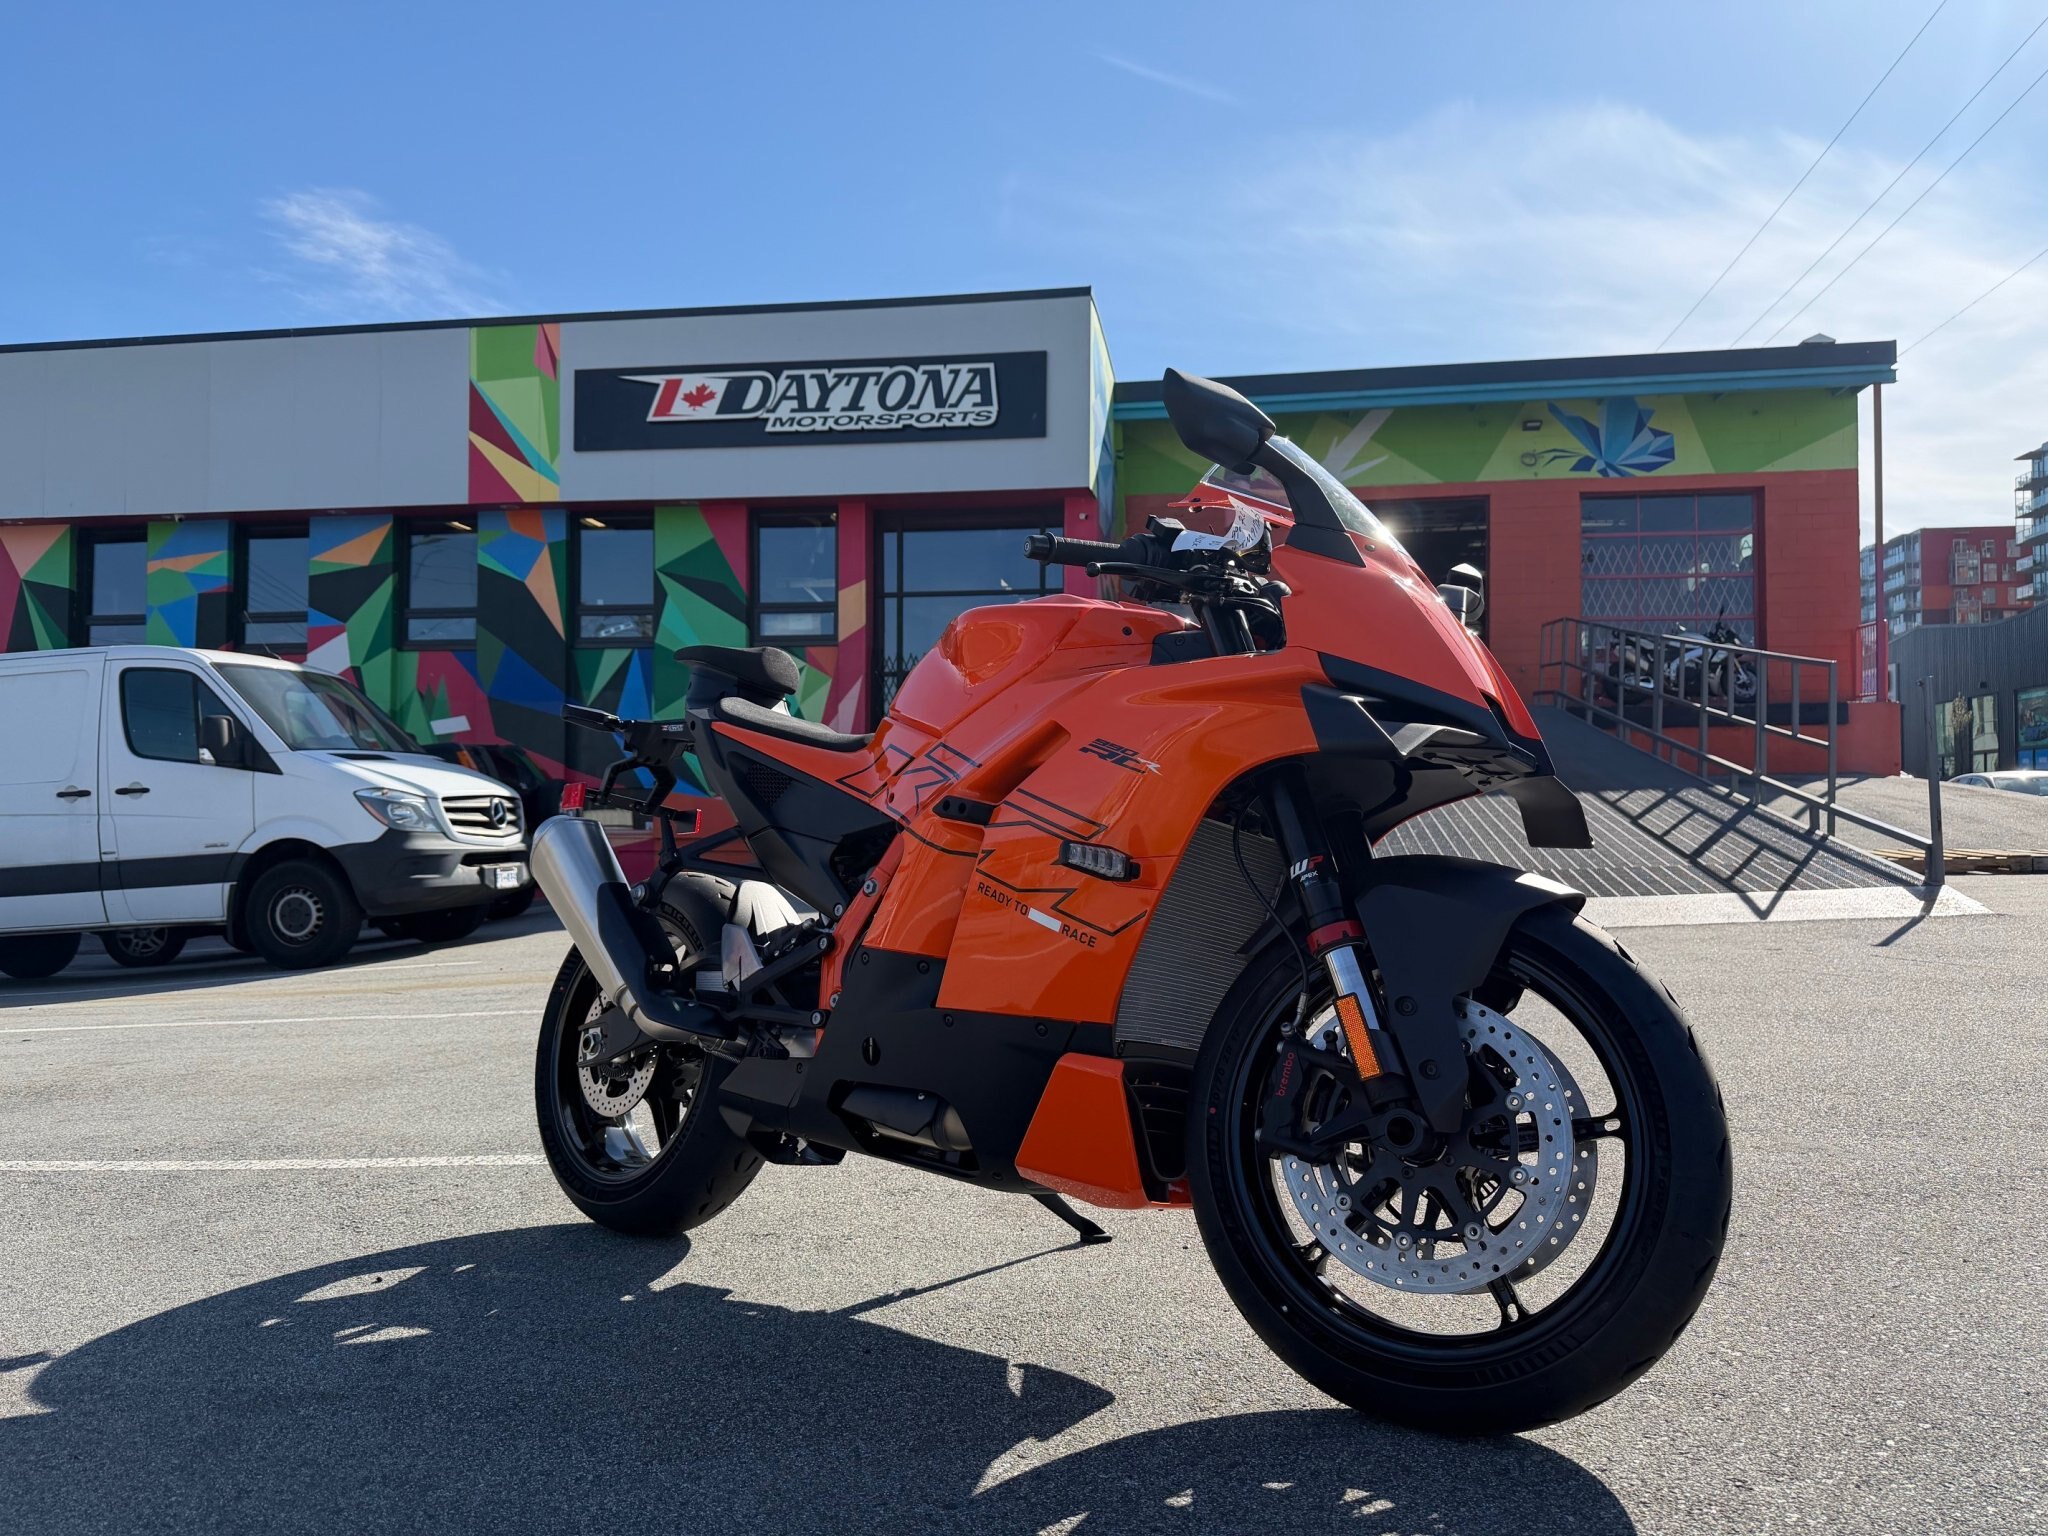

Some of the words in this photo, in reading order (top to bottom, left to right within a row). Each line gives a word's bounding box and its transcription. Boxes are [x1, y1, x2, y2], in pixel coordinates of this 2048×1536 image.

[715, 366, 995, 415] DAYTONA
[771, 409, 993, 429] MOTORSPORTS
[1088, 738, 1140, 757] 990
[1290, 855, 1324, 880] WP
[977, 881, 1013, 907] READY
[1014, 899, 1029, 916] TO
[1061, 923, 1097, 948] RACE
[1274, 1052, 1295, 1097] brembo
